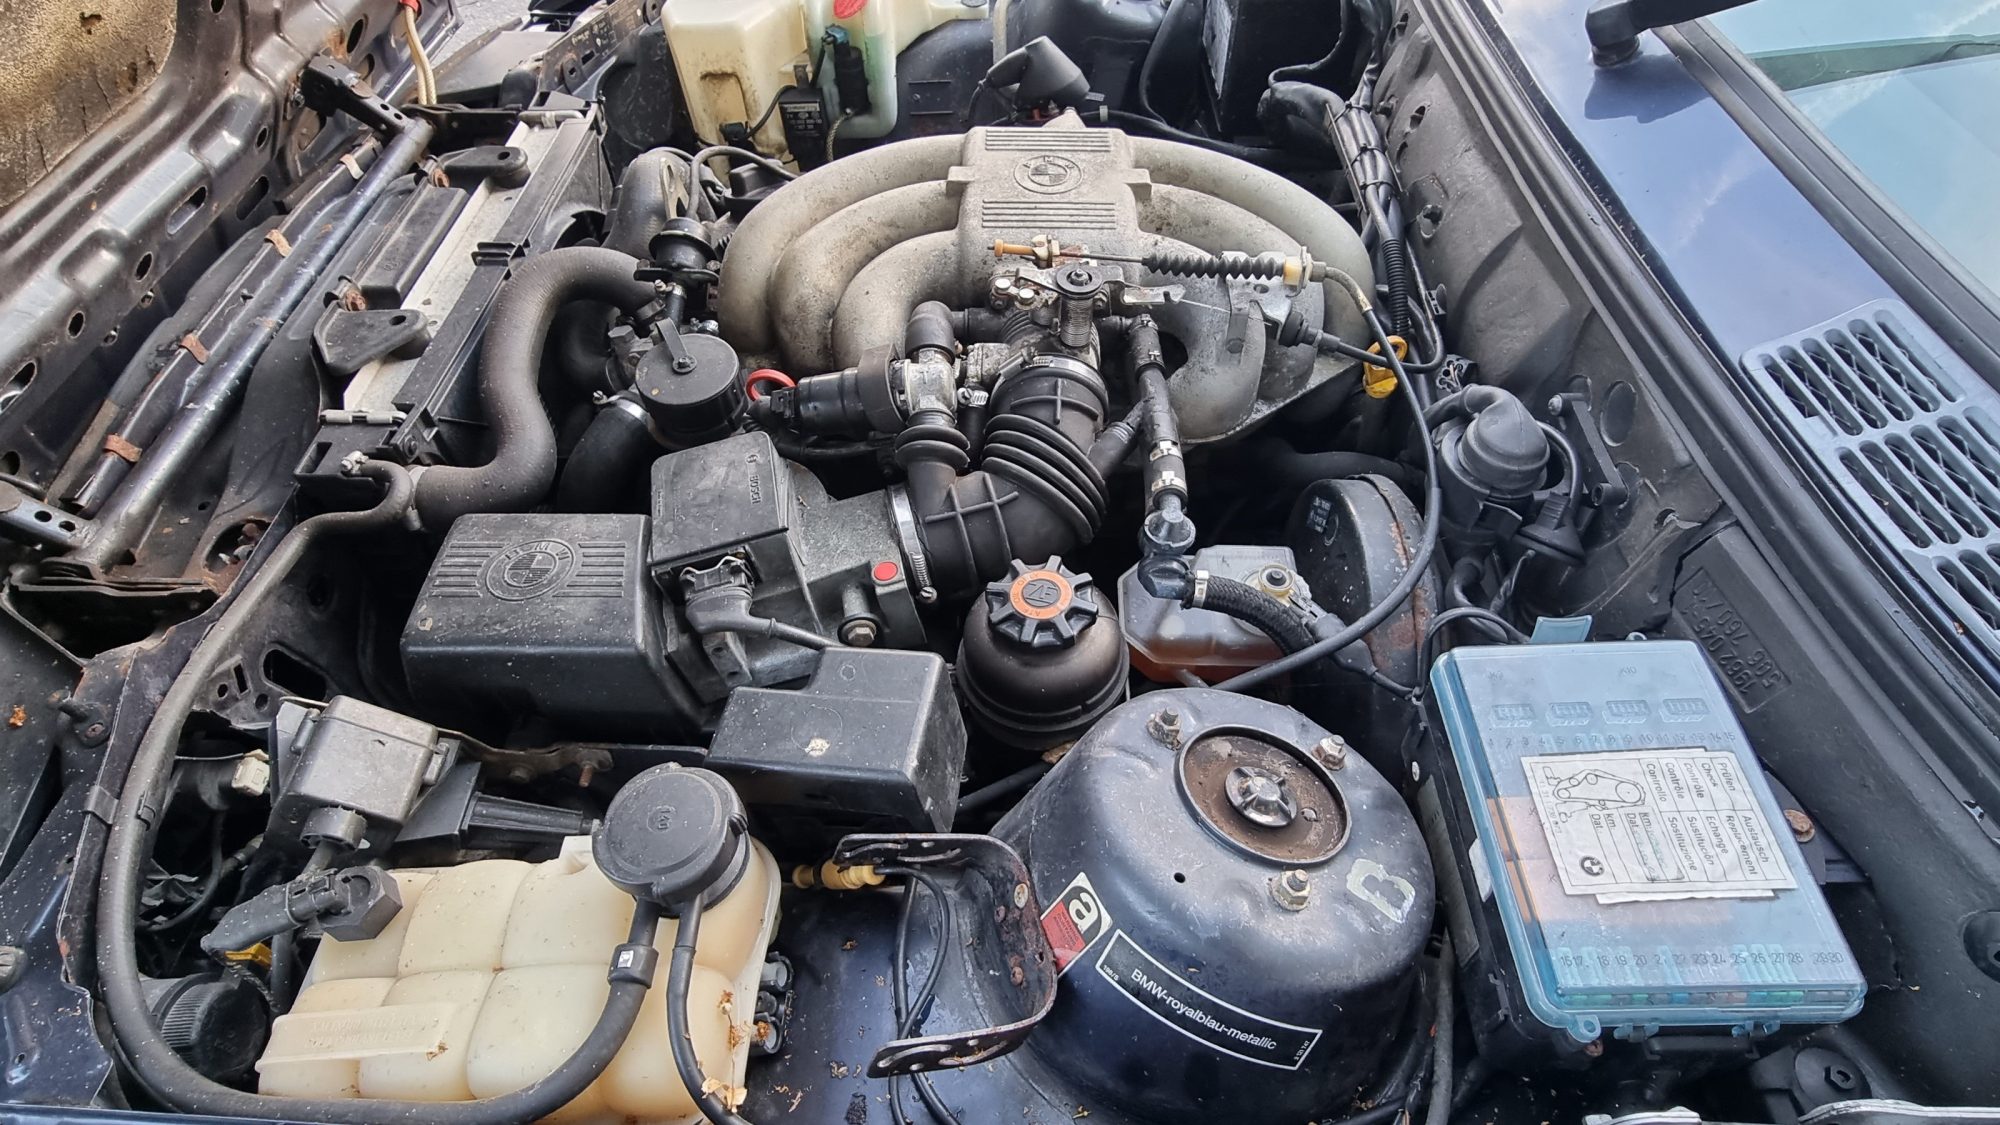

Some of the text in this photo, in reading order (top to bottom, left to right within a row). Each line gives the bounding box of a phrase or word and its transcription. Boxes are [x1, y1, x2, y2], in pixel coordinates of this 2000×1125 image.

[1646, 763, 1668, 802] Controllo
[1667, 816, 1698, 872] Sostituzione
[1701, 762, 1758, 875] Check Replacement
[1705, 816, 1728, 854] Echange
[1717, 762, 1770, 864] Prüfen Austausch
[1131, 968, 1277, 1050] BMW-royalblau-metallic
